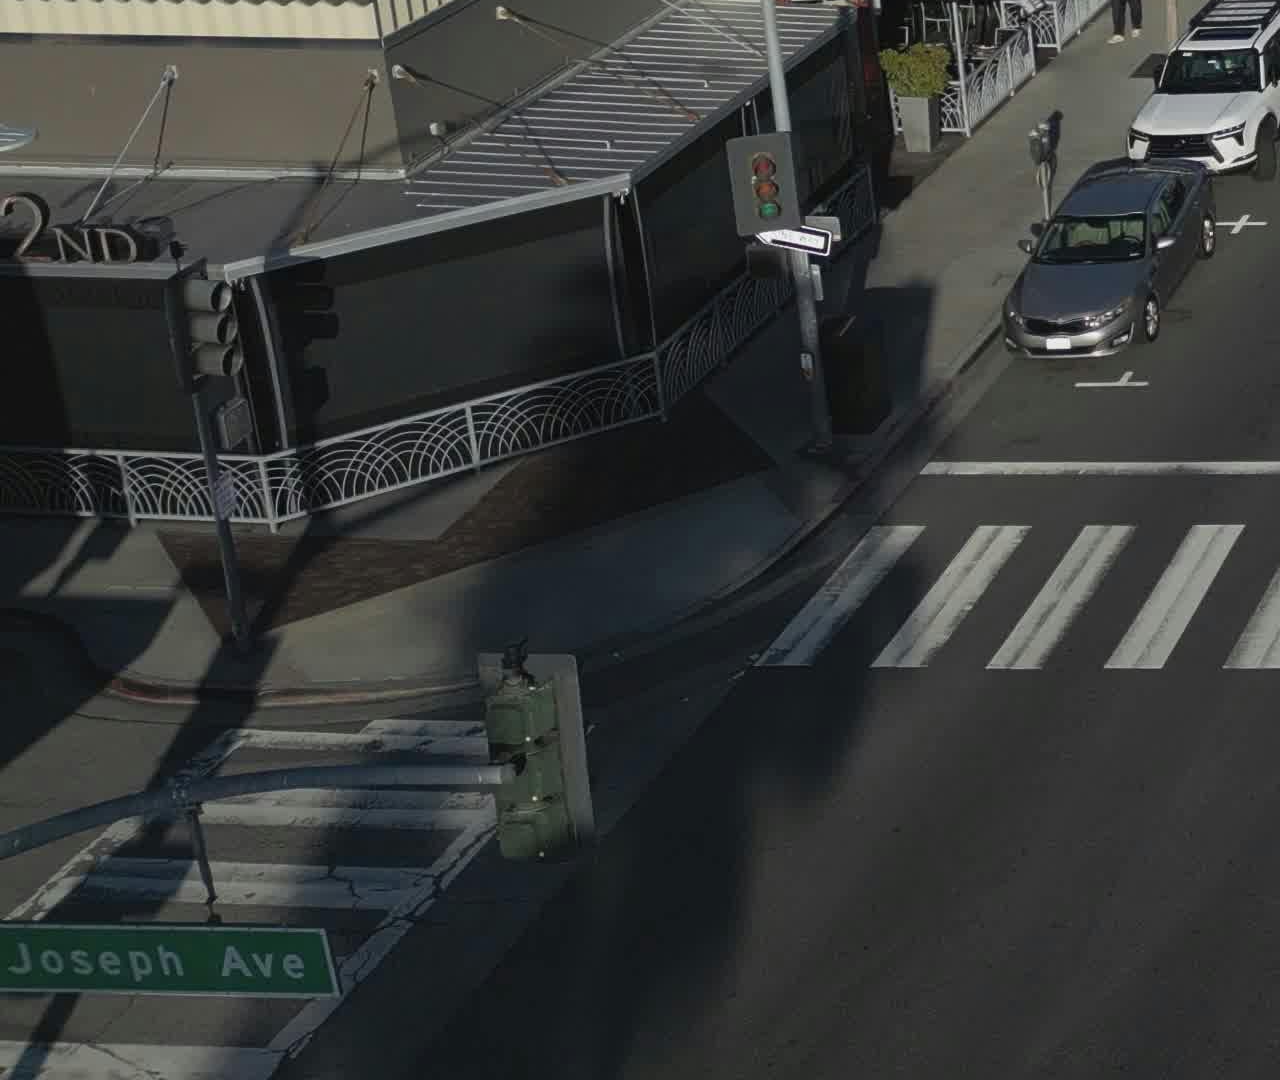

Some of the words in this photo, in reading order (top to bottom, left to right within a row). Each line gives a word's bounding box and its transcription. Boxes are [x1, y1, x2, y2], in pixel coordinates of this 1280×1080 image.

[0, 192, 137, 265] 2ND
[8, 943, 184, 982] Joseph
[221, 945, 305, 979] Ave
